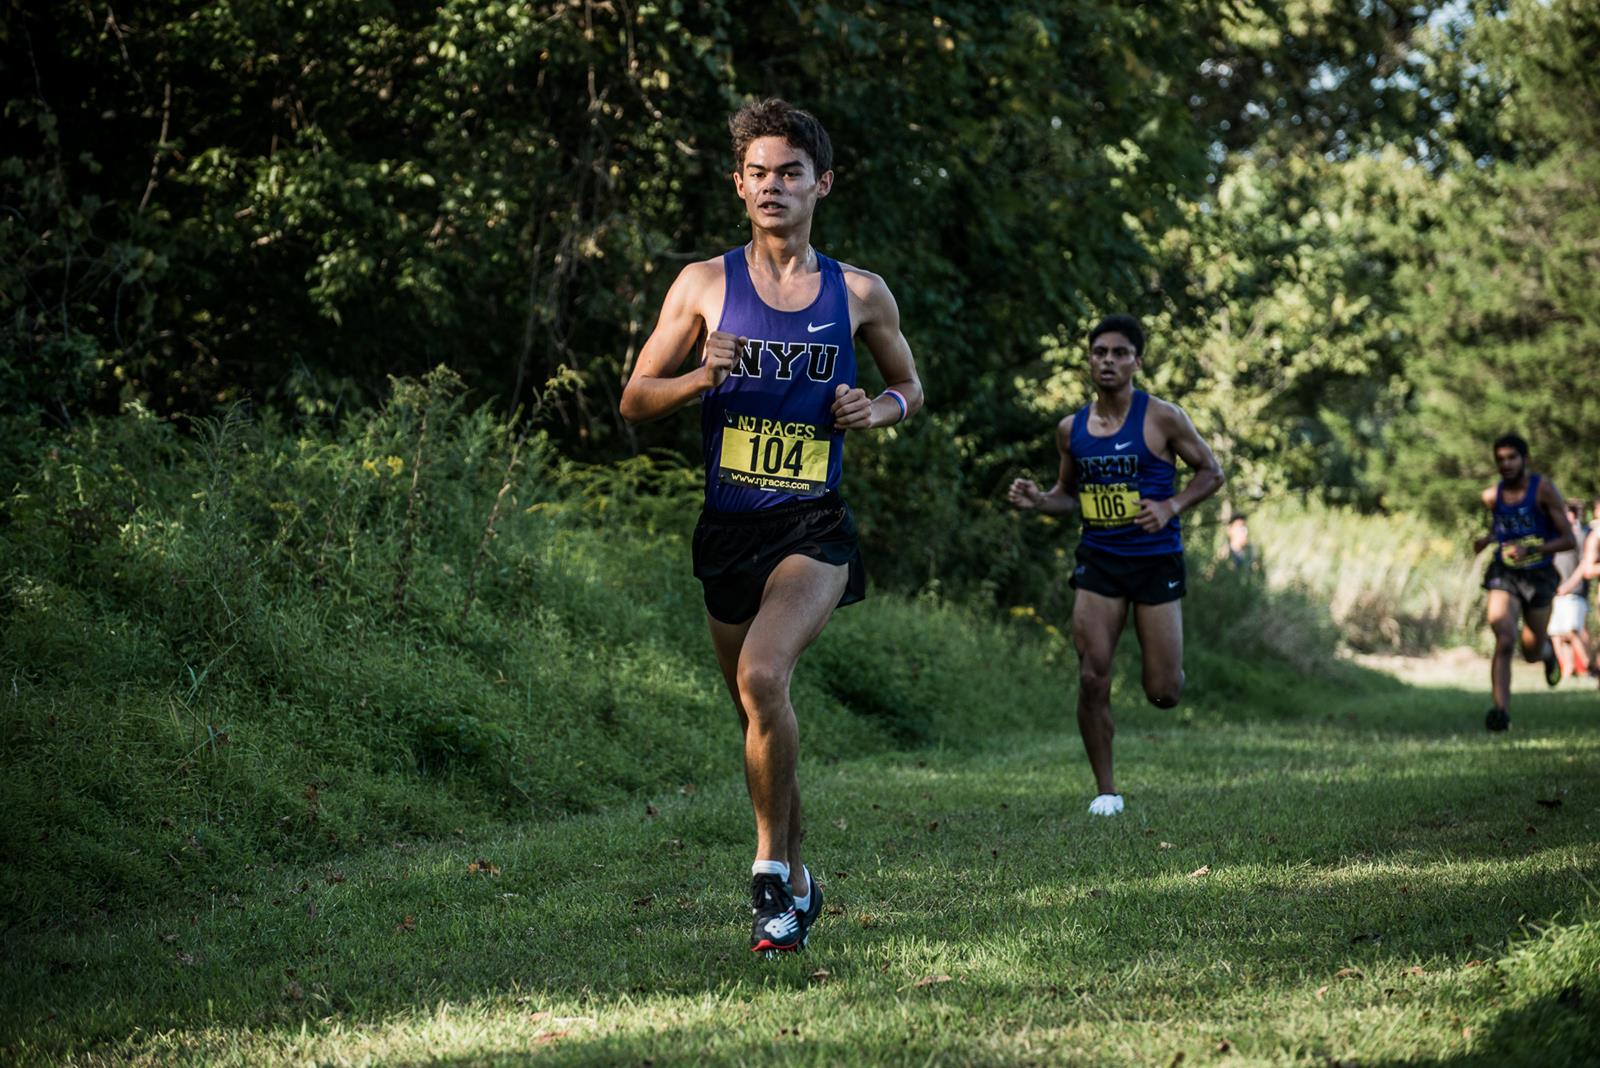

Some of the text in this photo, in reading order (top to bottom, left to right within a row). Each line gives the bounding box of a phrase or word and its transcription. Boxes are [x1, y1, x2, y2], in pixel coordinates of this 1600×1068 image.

[730, 338, 839, 383] NYU
[738, 415, 816, 440] NJ RACES
[749, 435, 804, 477] 104
[731, 473, 810, 490] www.njraces.com
[1093, 494, 1126, 518] 106
